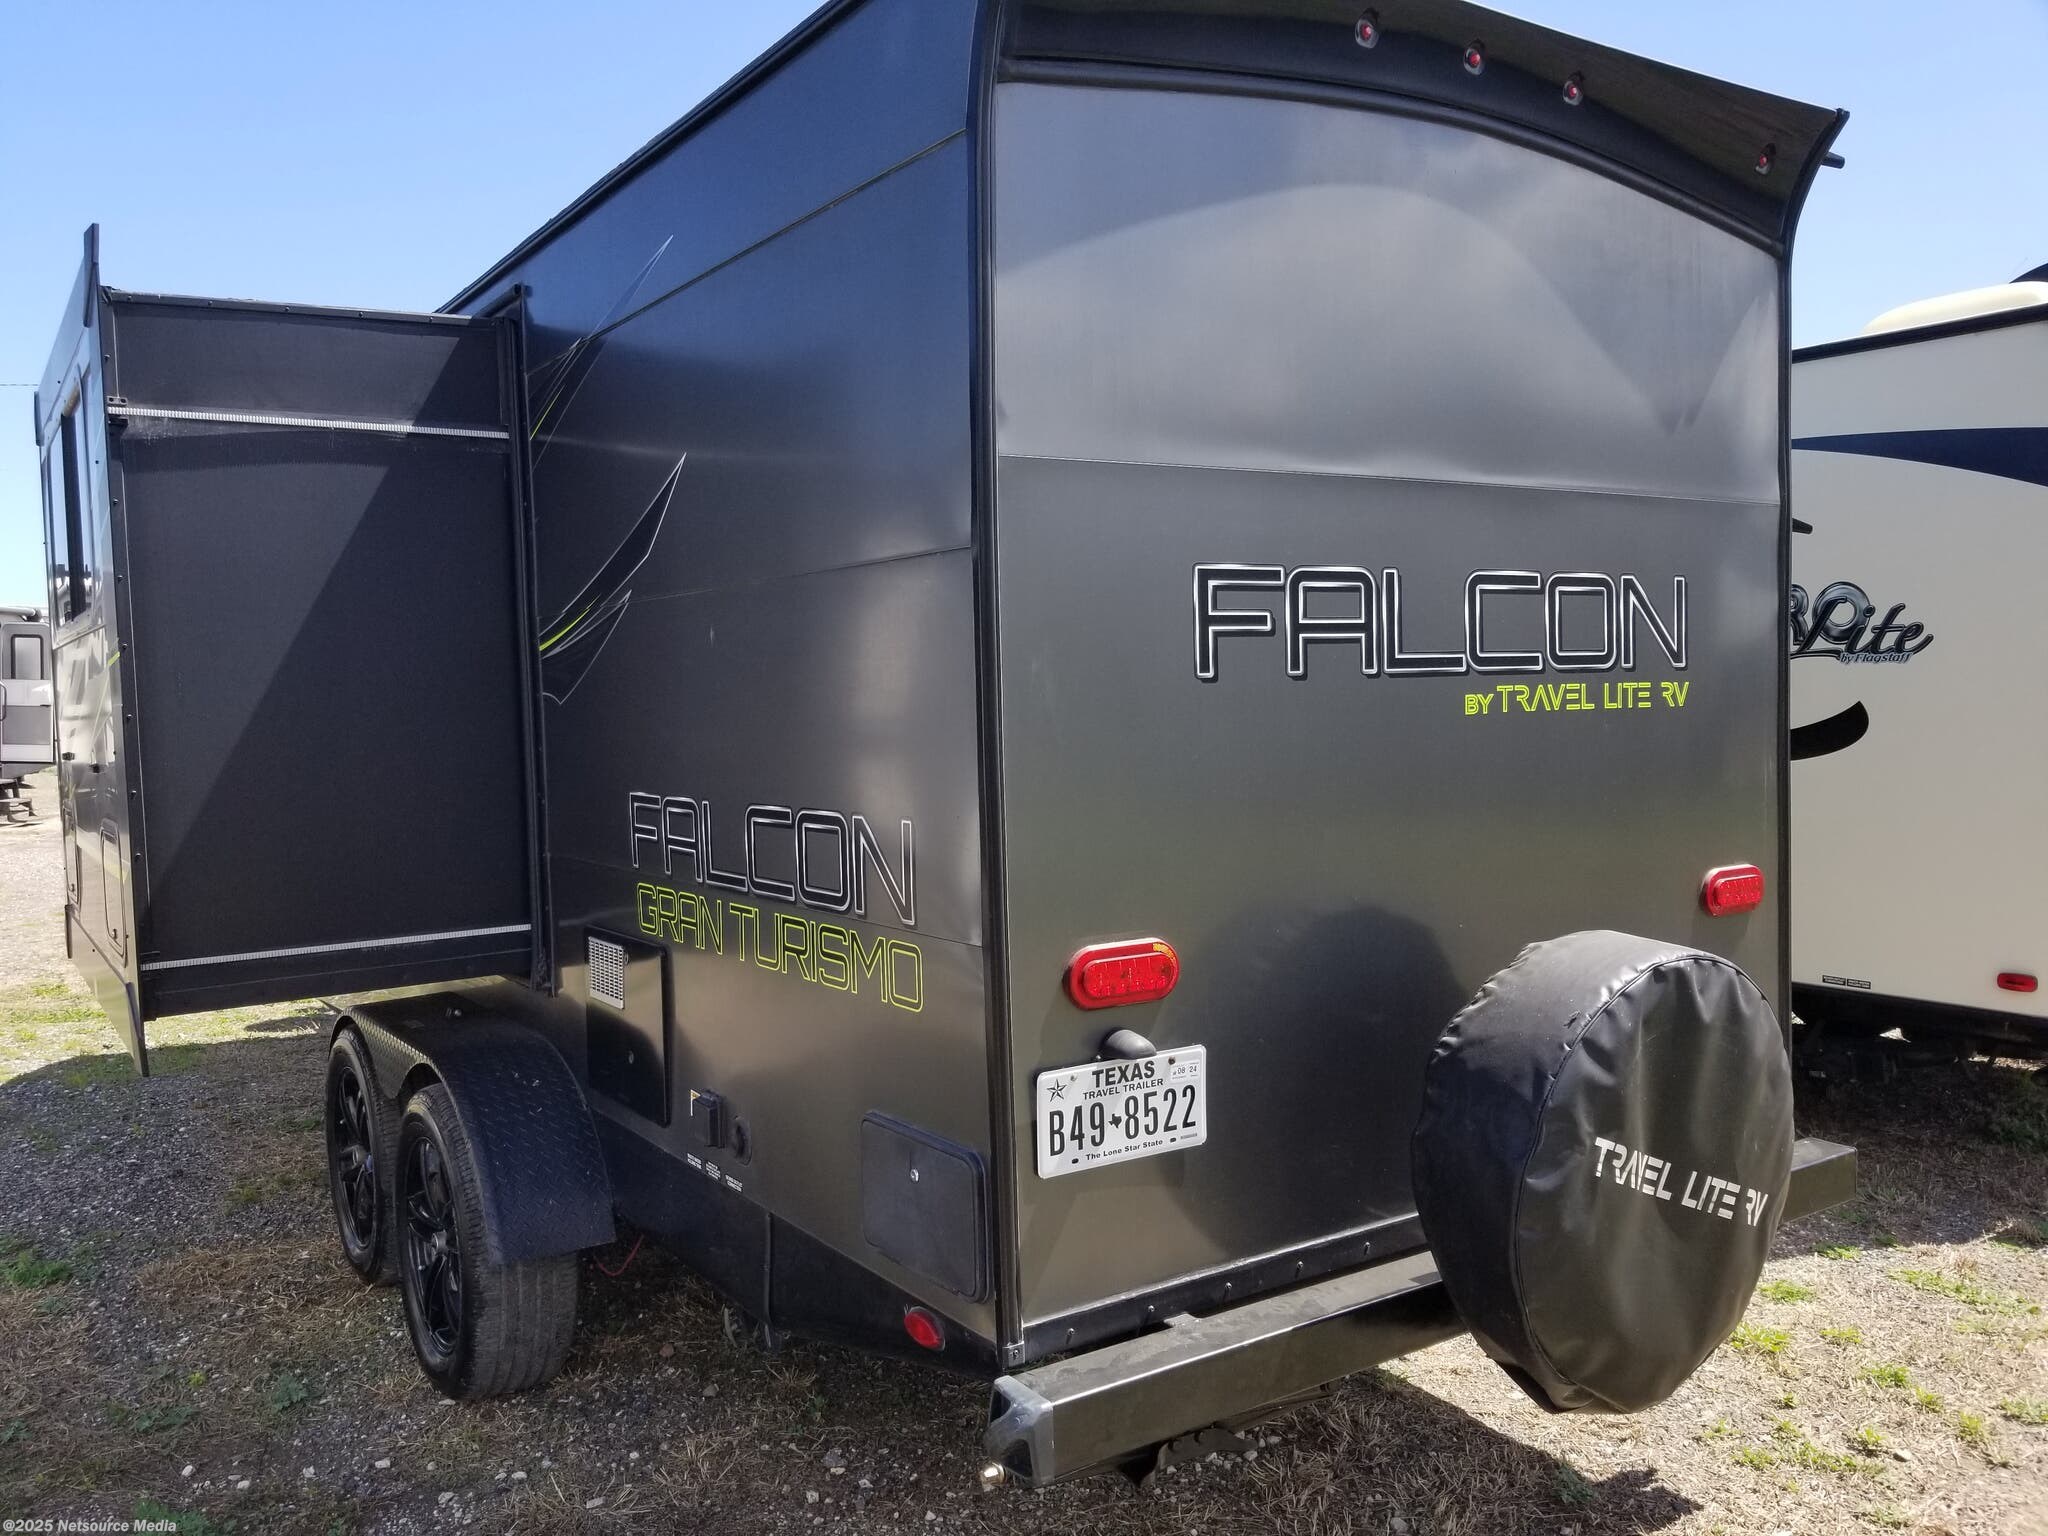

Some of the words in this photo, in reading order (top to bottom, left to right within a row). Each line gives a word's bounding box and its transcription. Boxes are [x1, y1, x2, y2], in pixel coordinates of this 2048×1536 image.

[1194, 563, 1688, 681] FALCON
[1841, 652, 1853, 664] by
[1854, 652, 1911, 663] Flagstaff
[1464, 693, 1494, 715] BY
[1497, 683, 1595, 713] TRAVEL
[1604, 682, 1650, 709] LITE
[1661, 681, 1690, 707] RV
[629, 791, 916, 926] FALCON
[637, 882, 722, 955] GRAN
[729, 902, 923, 1012] TURISMO
[1082, 1087, 1120, 1101] TRAVEL
[1123, 1078, 1164, 1093] TRAILER
[1092, 1061, 1155, 1088] TEXAS
[1085, 1152, 1101, 1161] The
[1103, 1148, 1122, 1157] Lone
[1124, 1143, 1141, 1152] Star
[1143, 1138, 1163, 1148] State
[1595, 1136, 1673, 1201] TRAVEL
[1681, 1170, 1741, 1220] LITE
[1745, 1188, 1769, 1227] RV
